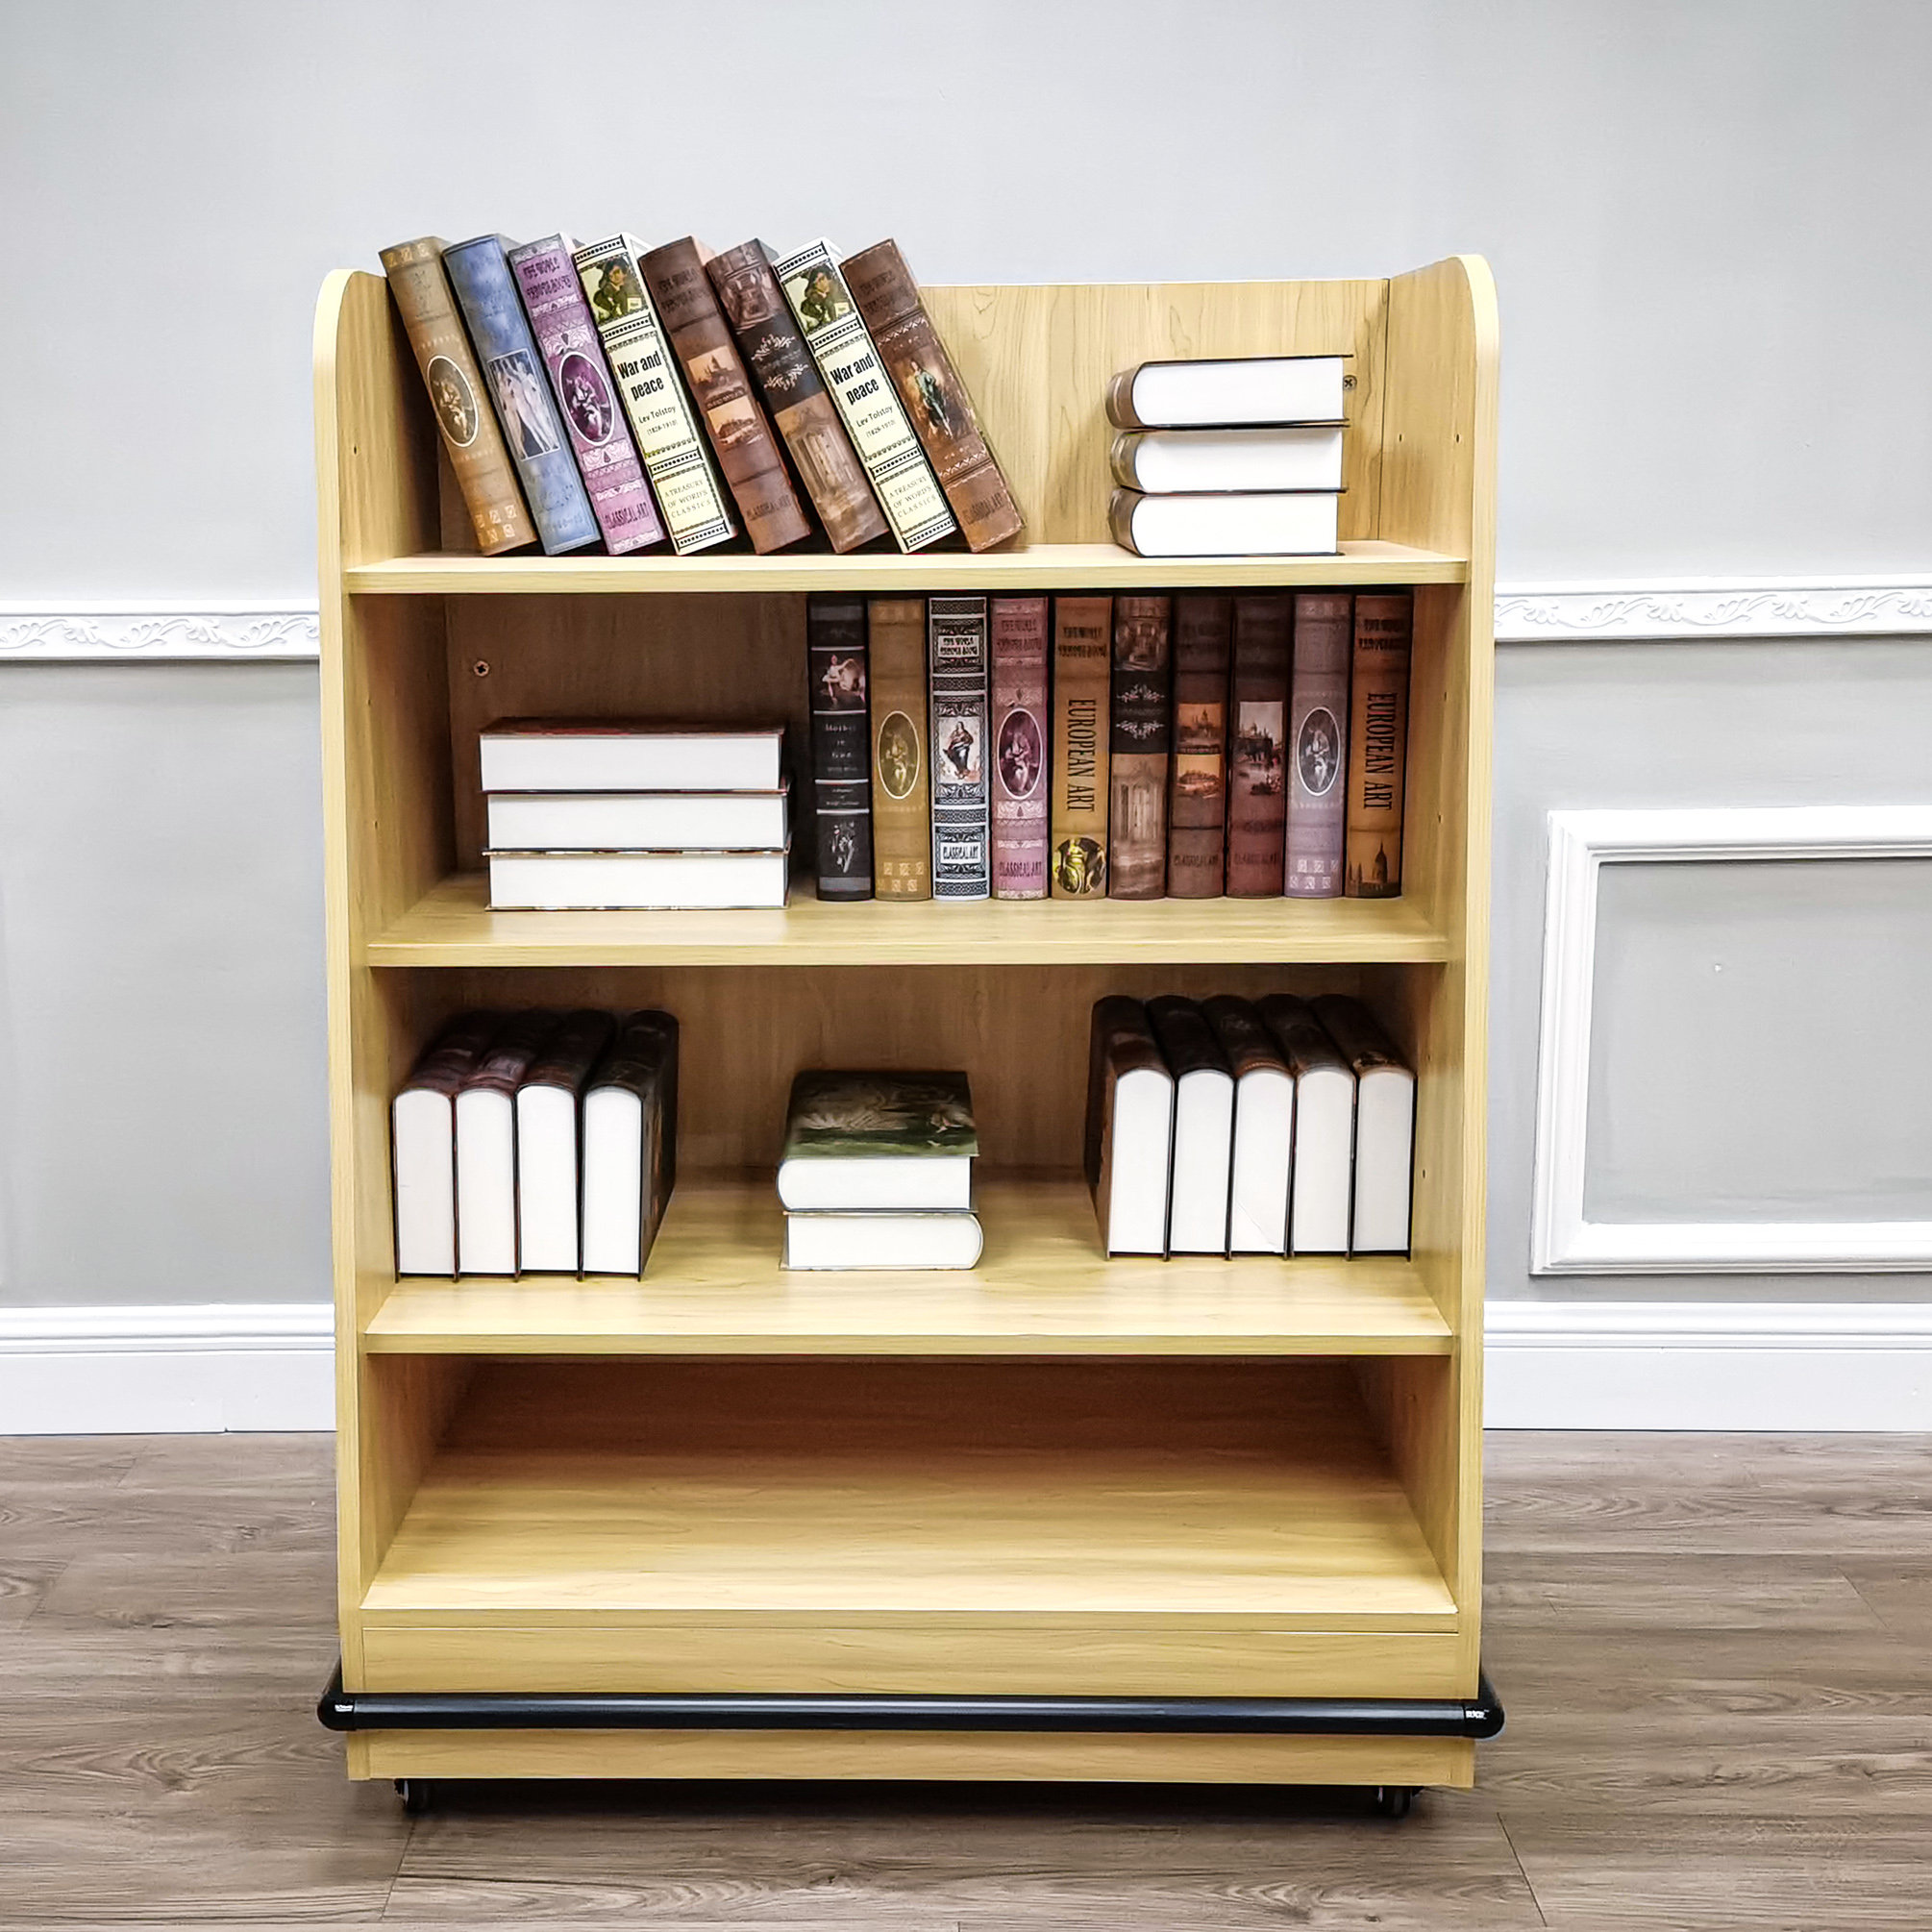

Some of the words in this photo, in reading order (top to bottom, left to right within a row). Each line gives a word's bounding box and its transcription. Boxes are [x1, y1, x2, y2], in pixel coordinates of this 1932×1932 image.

[617, 360, 640, 380] War
[640, 350, 661, 371] and
[830, 364, 854, 385] War
[854, 352, 875, 374] and
[631, 377, 664, 402] peace
[846, 379, 879, 406] peace
[638, 415, 650, 424] Lev
[650, 406, 677, 418] Tolstoy
[855, 417, 869, 427] Lev
[869, 406, 893, 420] Tolstoy
[671, 500, 711, 518] CLASSICS
[893, 500, 903, 508] OF
[1067, 699, 1096, 778] EUROPEAN
[1365, 692, 1397, 775] EUROPEAN
[1067, 784, 1096, 812] ART
[1363, 780, 1393, 810] ART
